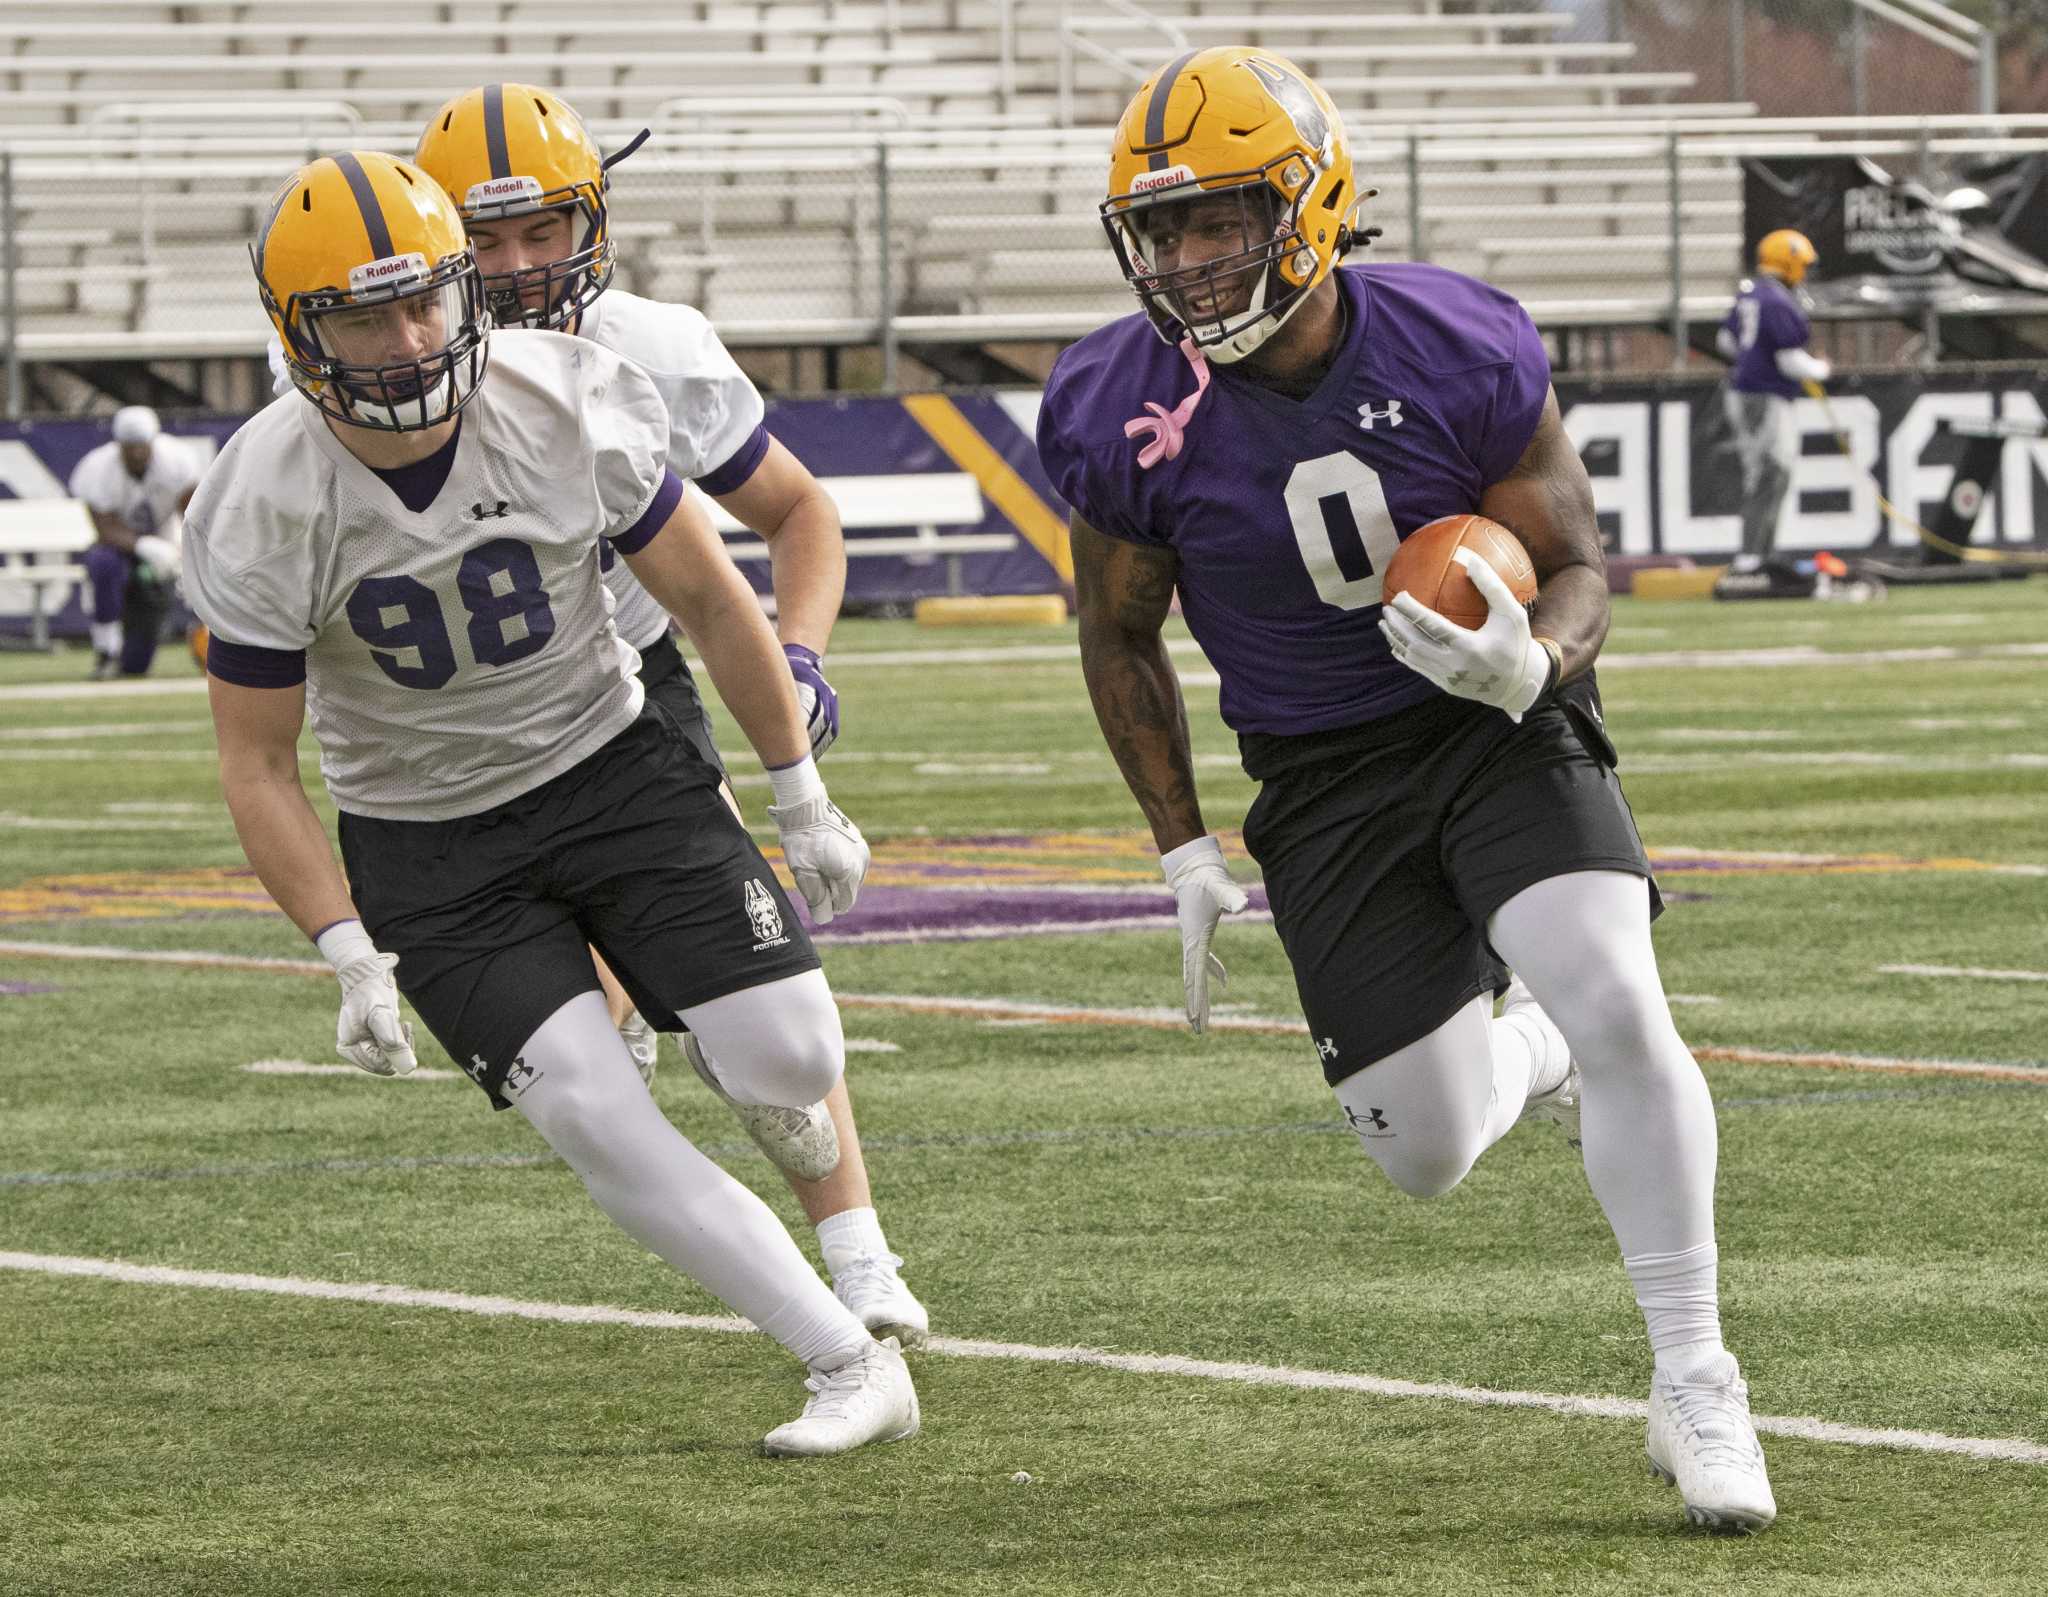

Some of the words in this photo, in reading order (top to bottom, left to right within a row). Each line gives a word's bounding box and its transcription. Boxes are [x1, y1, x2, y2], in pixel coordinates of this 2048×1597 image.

[483, 180, 523, 196] Riddell
[1135, 170, 1185, 192] Riddell
[366, 258, 409, 278] Riddell
[1283, 450, 1401, 611] 0
[346, 537, 556, 690] 98
[753, 936, 791, 952] FOOTBALL
